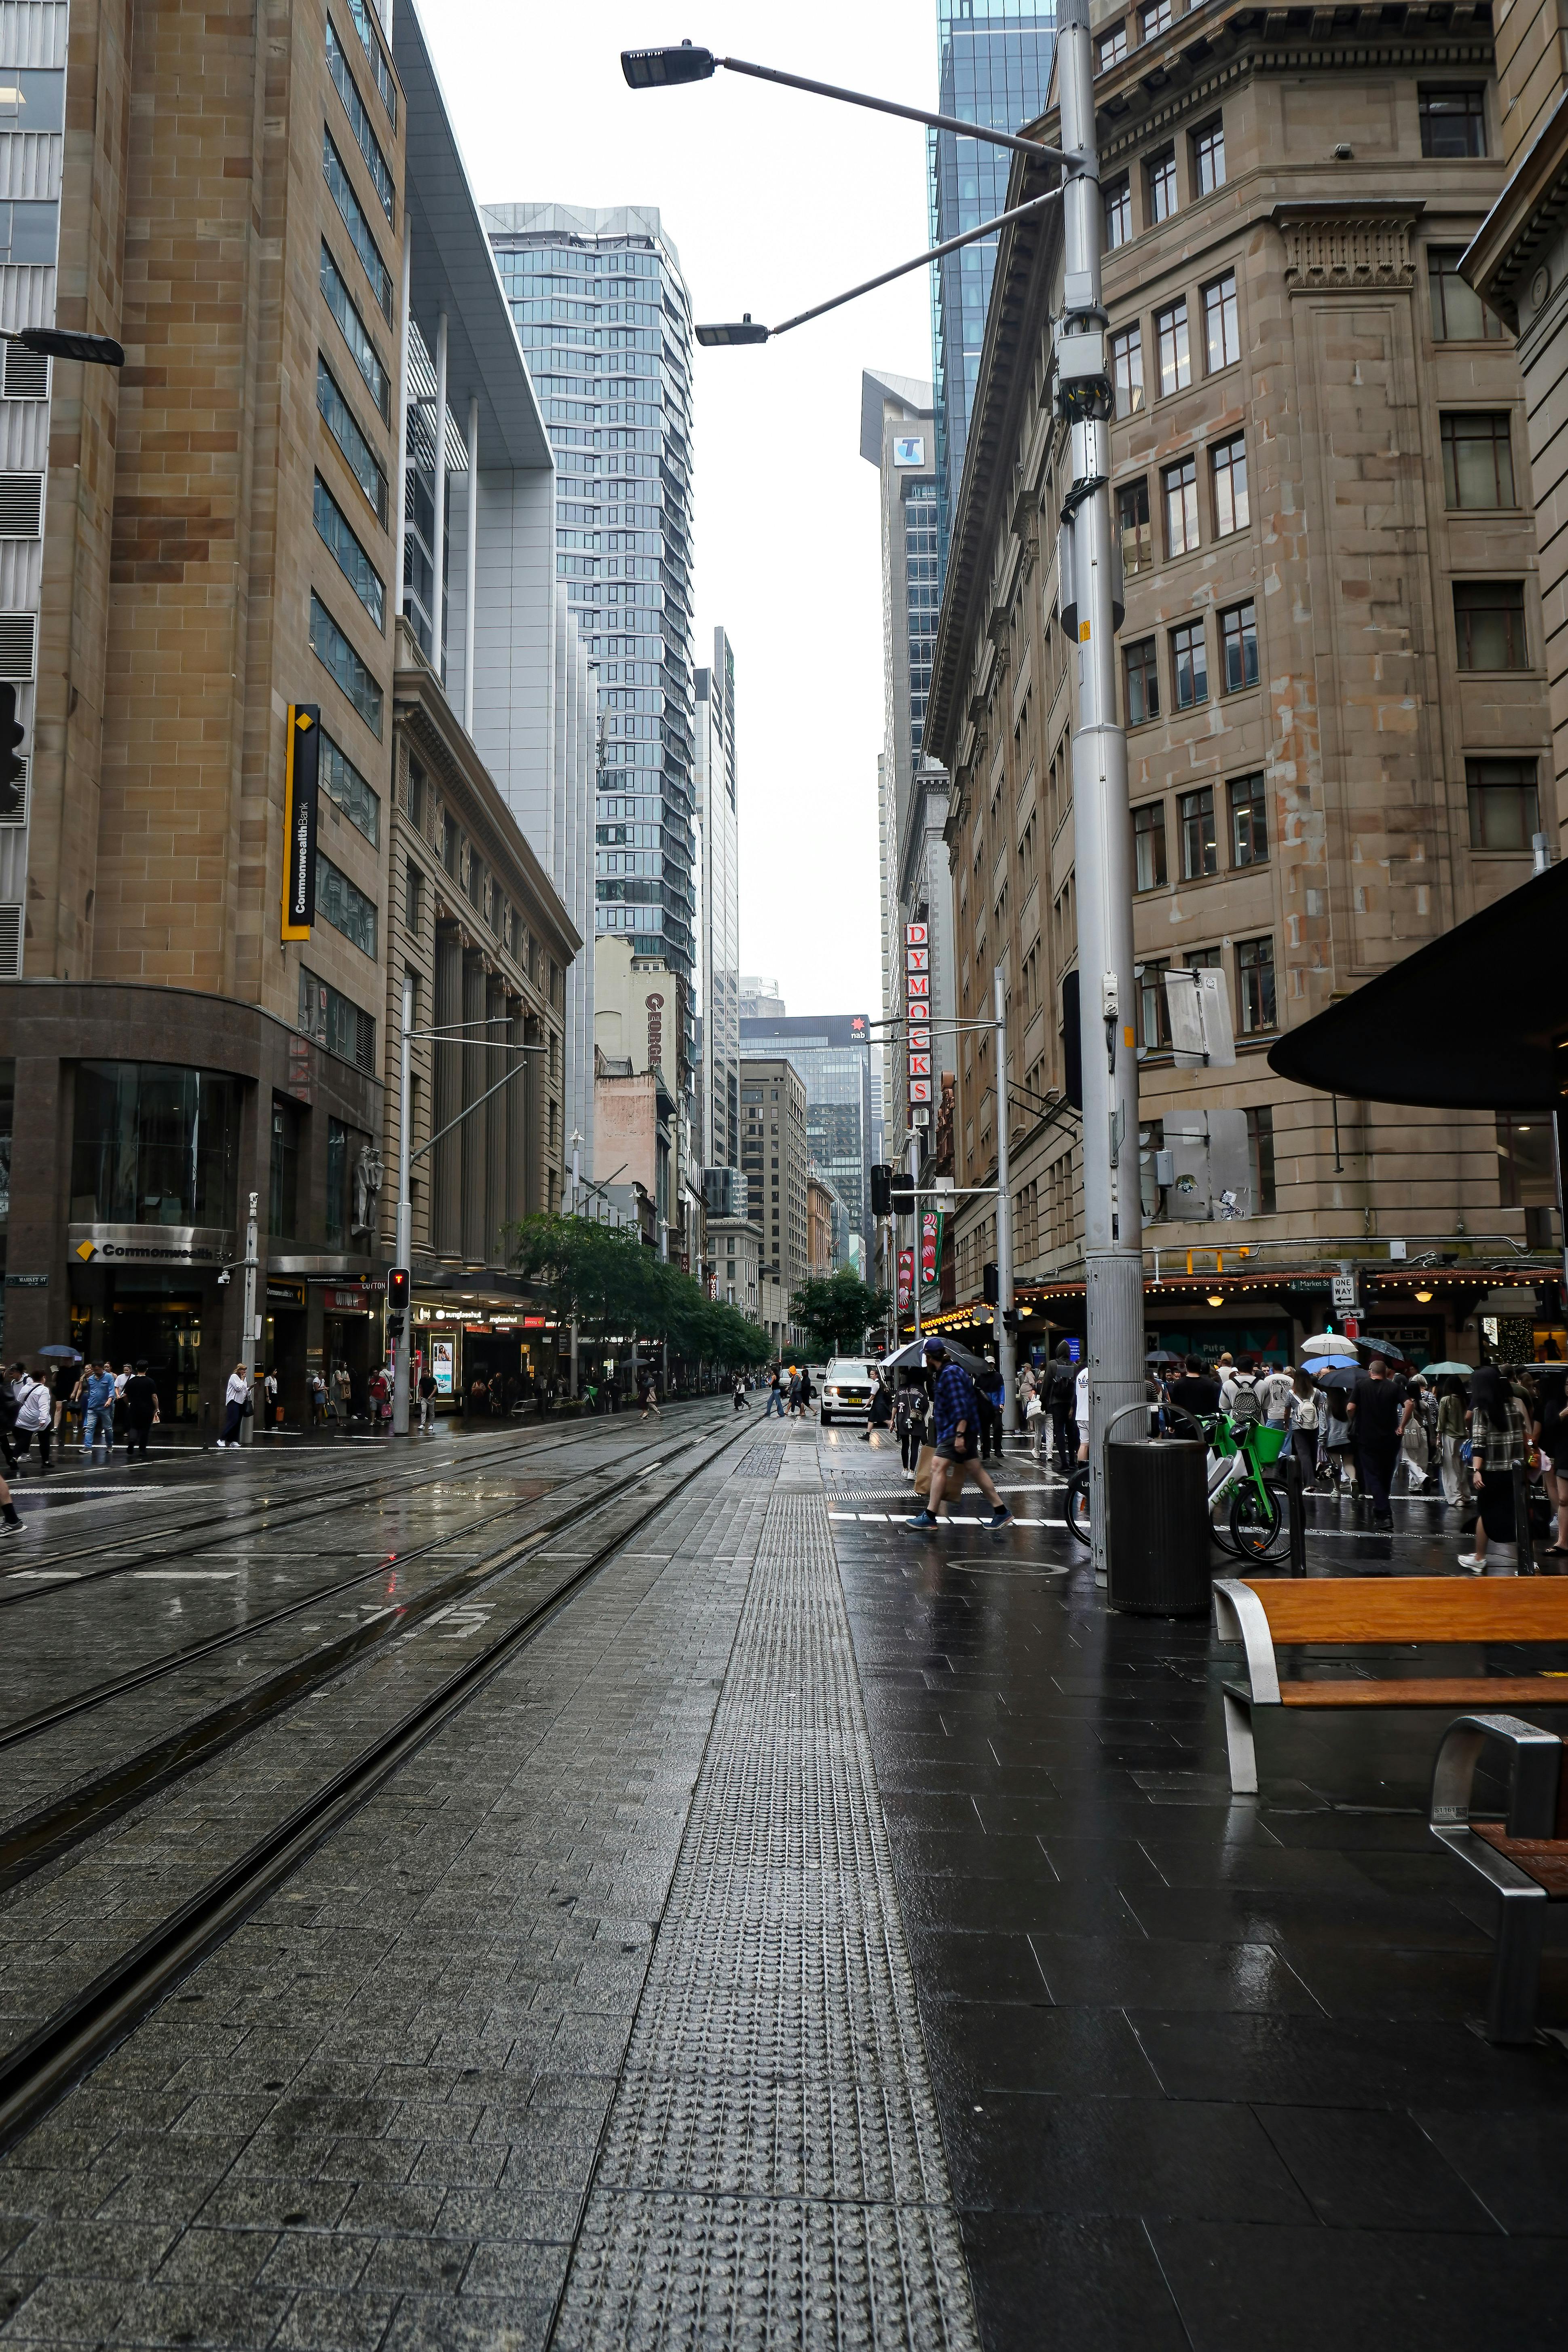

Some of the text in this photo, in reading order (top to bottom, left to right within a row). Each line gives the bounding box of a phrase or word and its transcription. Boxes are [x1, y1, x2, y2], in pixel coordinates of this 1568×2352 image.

[902, 439, 920, 457] T
[295, 802, 309, 914] CommonwealthBank
[646, 993, 665, 1065] GEORGE
[909, 926, 928, 1099] DYMOCKS
